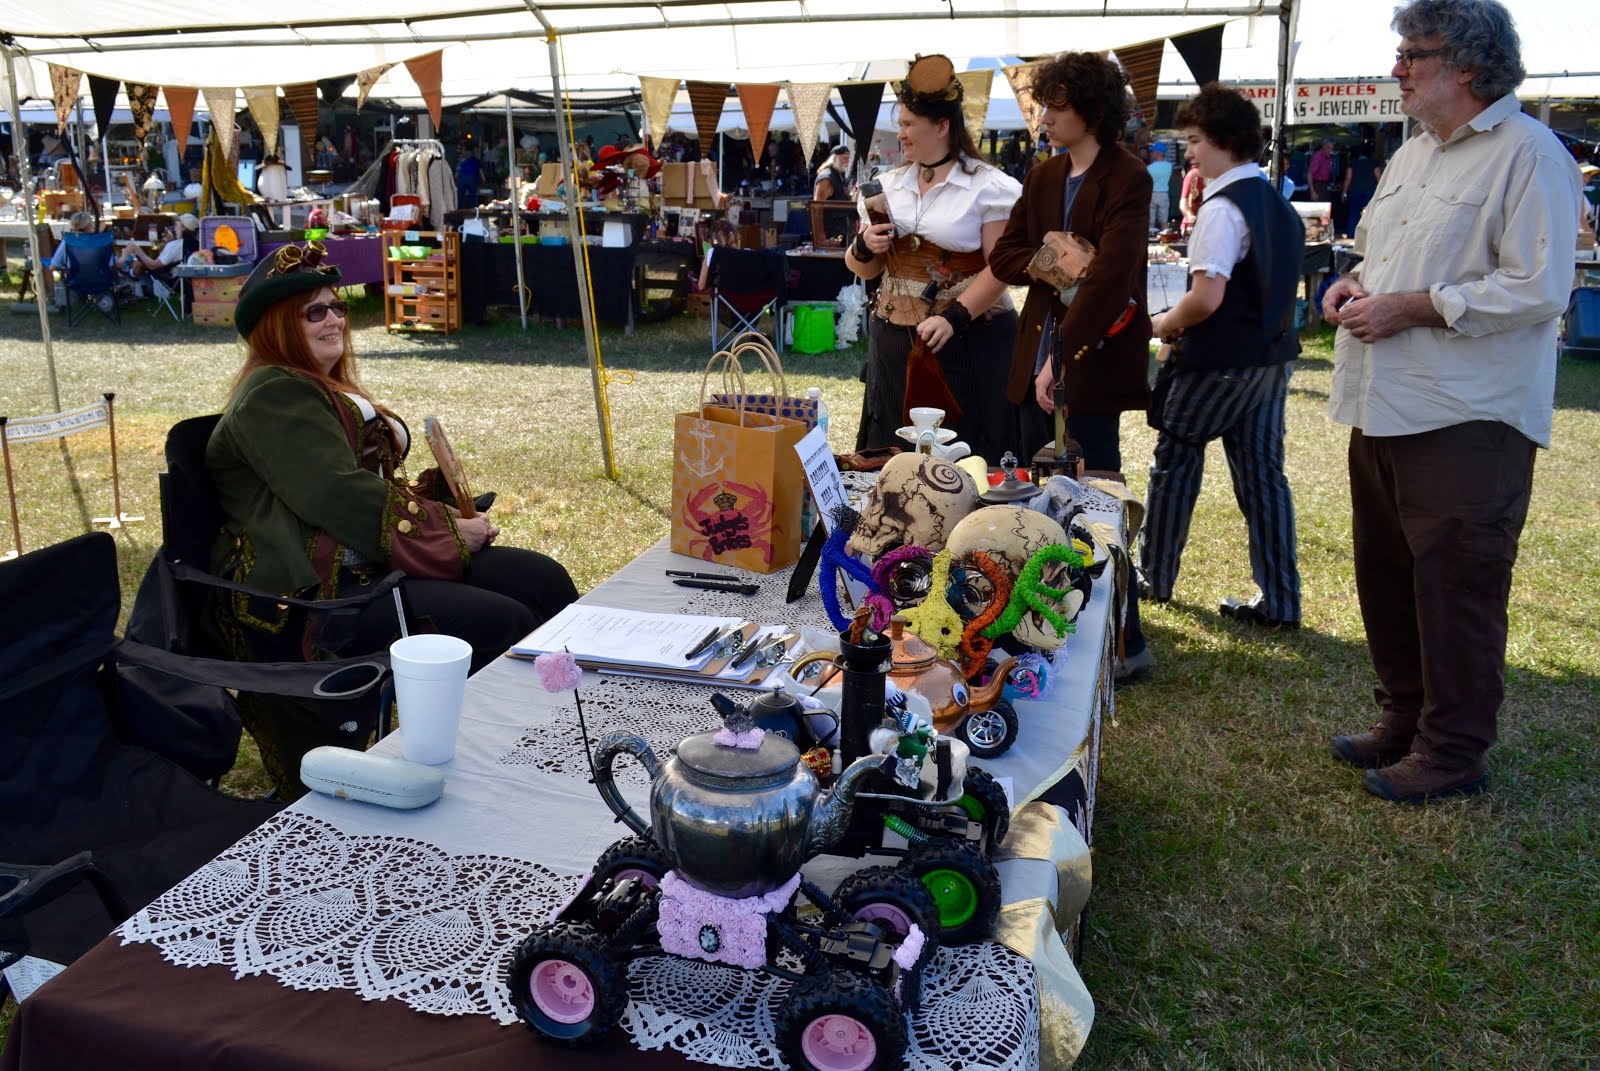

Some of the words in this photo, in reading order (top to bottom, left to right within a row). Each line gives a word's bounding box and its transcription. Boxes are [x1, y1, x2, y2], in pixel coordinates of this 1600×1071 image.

[1239, 87, 1277, 98] PART
[1297, 86, 1310, 97] &
[1319, 84, 1376, 96] PIECES
[1317, 100, 1369, 116] JEWELRY
